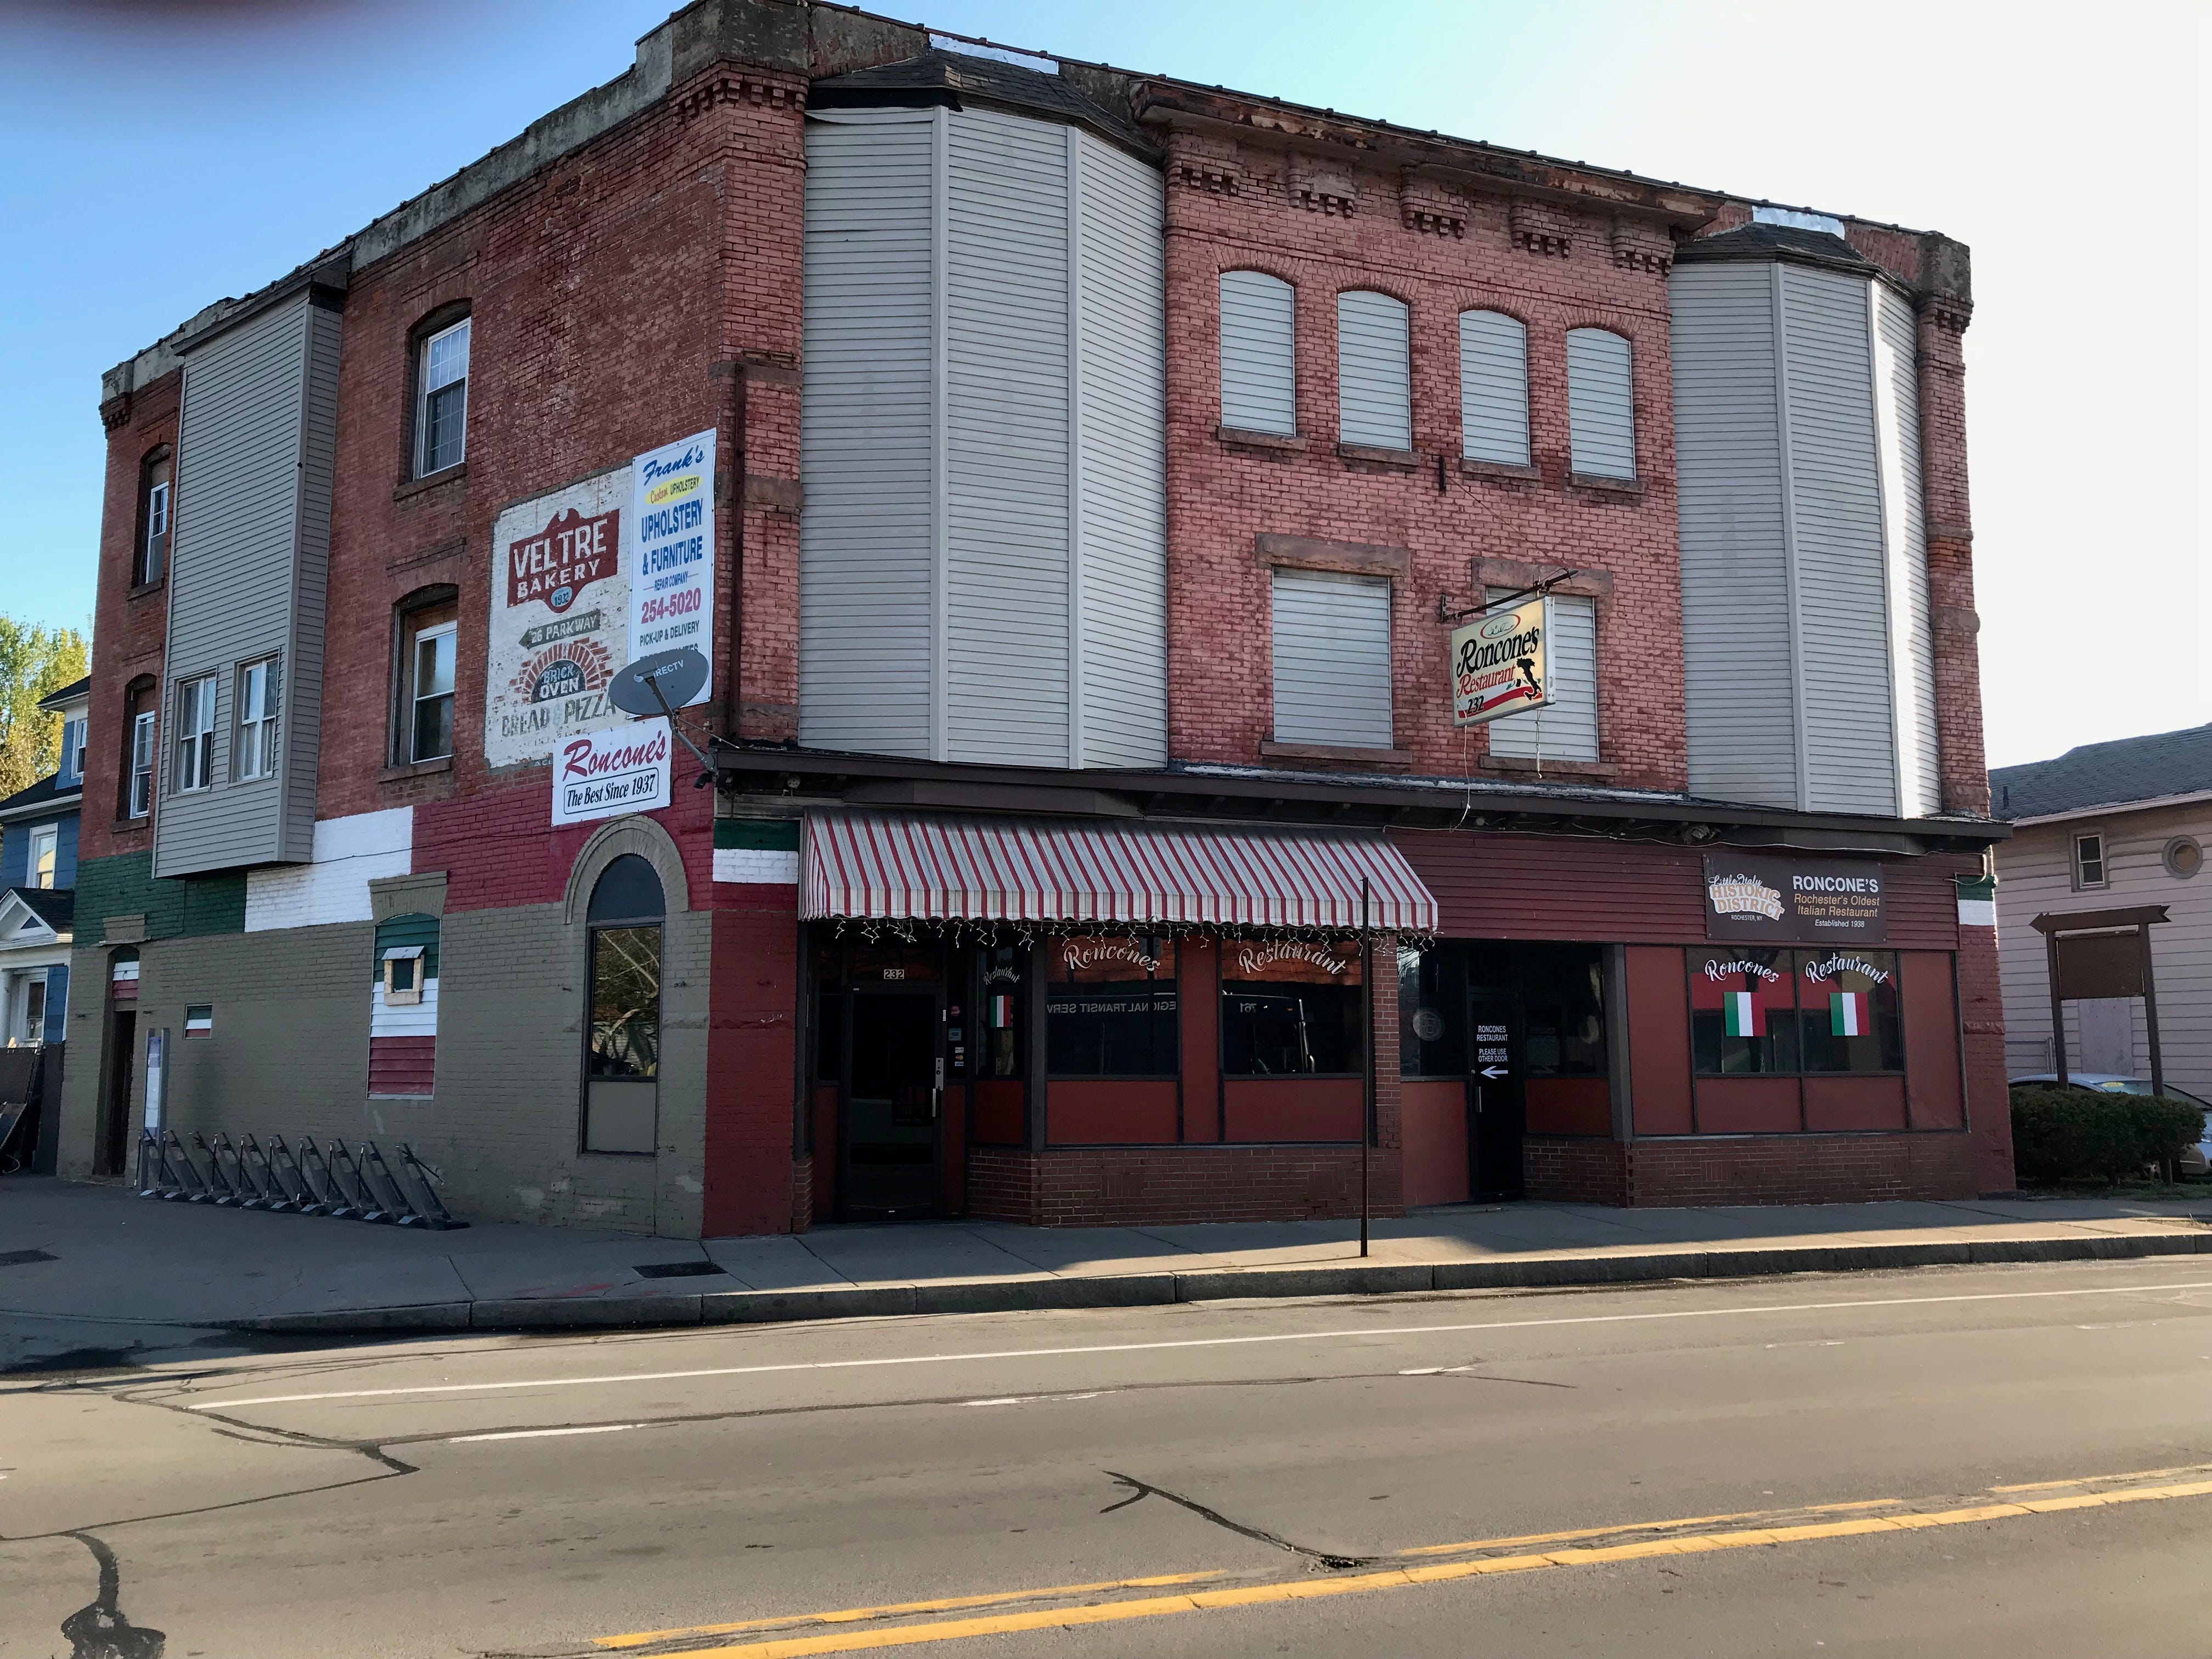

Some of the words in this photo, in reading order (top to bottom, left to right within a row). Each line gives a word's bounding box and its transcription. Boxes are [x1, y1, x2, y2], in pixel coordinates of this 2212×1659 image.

[642, 445, 704, 486] Frank's
[670, 476, 699, 495] UPHOLSTERY
[641, 498, 703, 543] UPHOLSTERY
[514, 518, 608, 578] VELTRE
[642, 552, 648, 575] &
[651, 535, 703, 573] FURNITURE
[517, 558, 600, 599] BAKERY
[654, 577, 668, 591] REPAIR
[669, 571, 688, 588] COMPANY
[641, 587, 701, 624] 254-5020
[531, 629, 543, 643] 26
[546, 615, 597, 640] PARKWAY
[640, 630, 663, 647] PICK-UP
[665, 629, 669, 640] &
[670, 620, 699, 639] DELIVERY
[1457, 626, 1539, 678] Roncone's
[543, 665, 574, 683] BRICK
[1457, 663, 1516, 698] Restaurant
[539, 678, 579, 698] OVEN
[501, 707, 550, 737] BREAD
[564, 693, 617, 724] PIZZA
[1467, 695, 1484, 714] 232
[562, 730, 667, 782] Roncone's
[567, 788, 583, 807] The
[584, 786, 603, 805] Best
[605, 782, 629, 800] Since
[632, 774, 656, 795] 1937
[1708, 874, 1736, 886] Little
[1737, 873, 1763, 888] Italy
[1792, 876, 1878, 893] RONCONE'S
[1710, 884, 1780, 904] HISTORIC
[1794, 893, 1848, 905] Rochester's
[1850, 895, 1880, 906] Oldest
[1716, 898, 1784, 919] DISTRICT
[1797, 905, 1825, 915] Italian
[1829, 906, 1877, 917] Restaurant
[1815, 919, 1849, 927] Established
[1063, 945, 1160, 971] Roncones
[1239, 939, 1346, 974] Restaurant
[1805, 952, 1889, 984] Restaurant
[885, 969, 904, 979] 232
[983, 966, 1020, 985] Restaurant
[1705, 960, 1781, 983] Roncones
